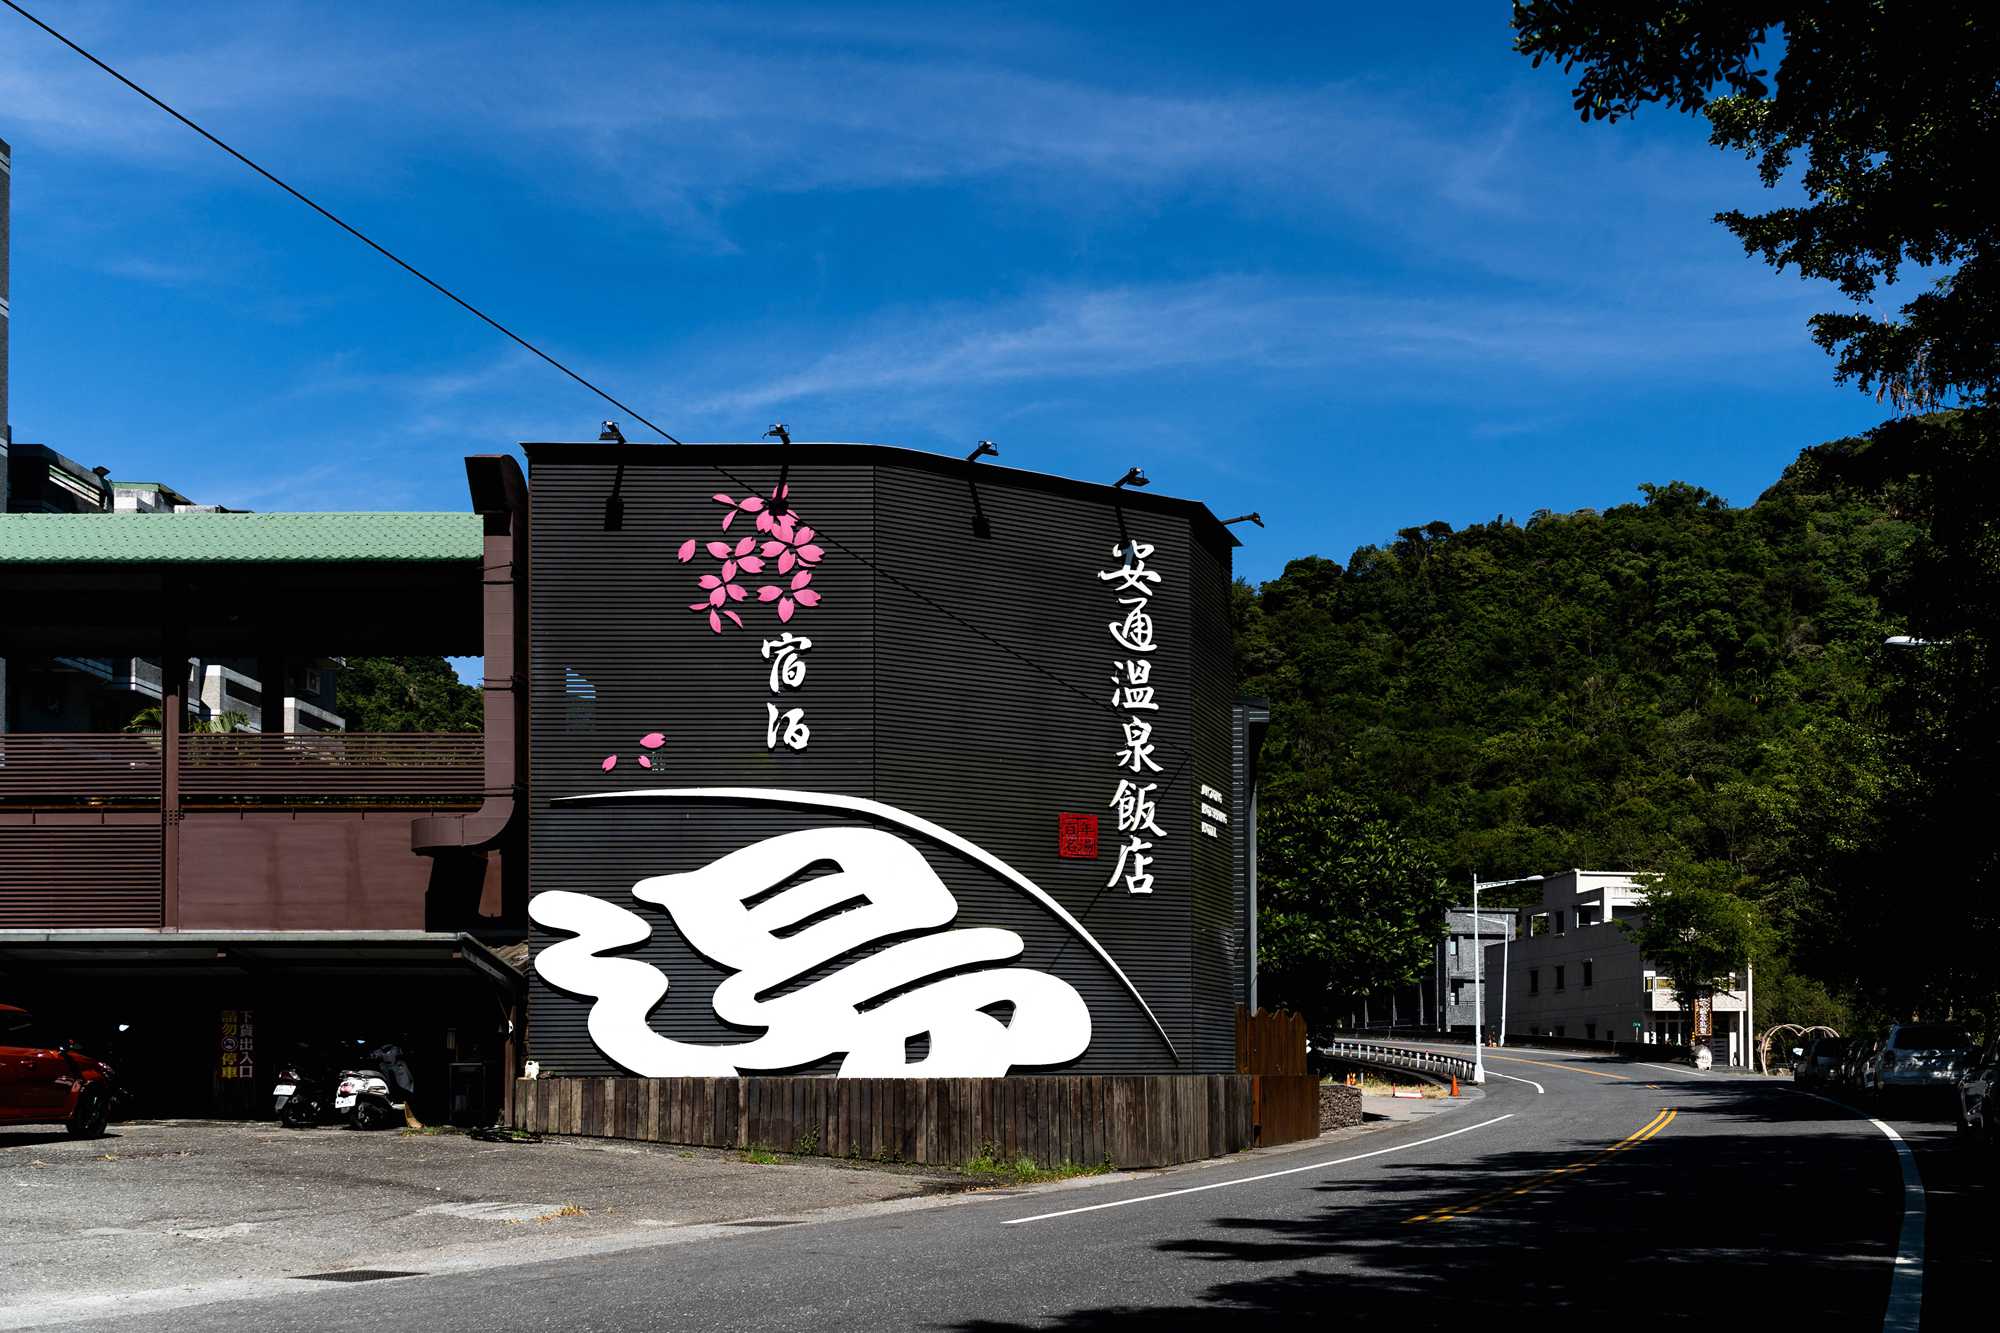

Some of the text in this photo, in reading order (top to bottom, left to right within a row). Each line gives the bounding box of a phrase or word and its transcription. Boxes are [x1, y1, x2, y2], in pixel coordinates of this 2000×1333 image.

[761, 632, 811, 750] 宿泊
[1098, 540, 1167, 893] 安通溫泉飯店
